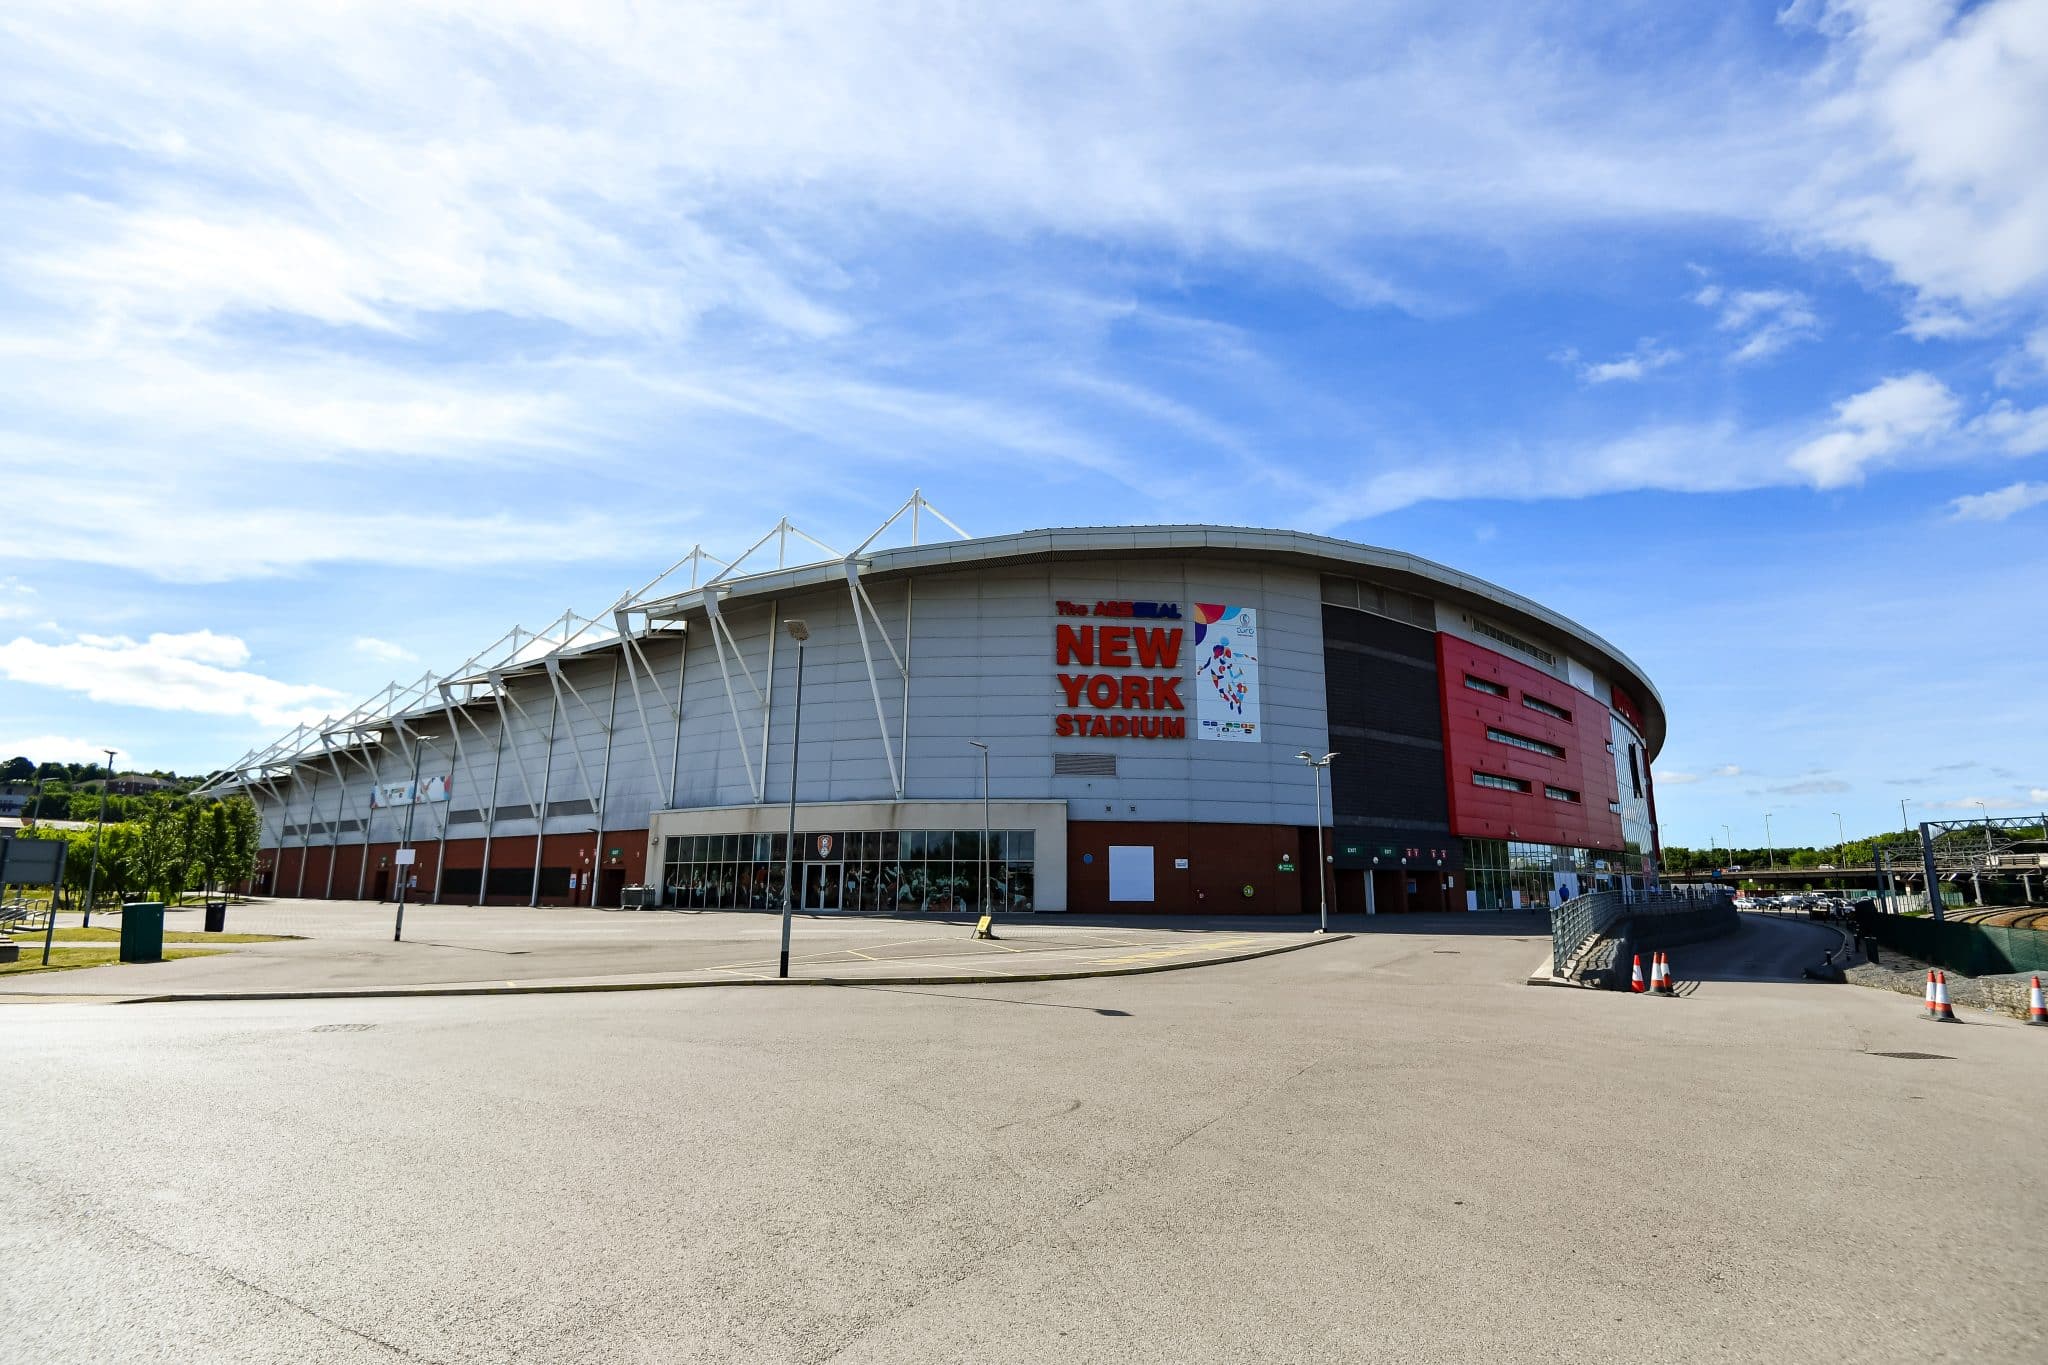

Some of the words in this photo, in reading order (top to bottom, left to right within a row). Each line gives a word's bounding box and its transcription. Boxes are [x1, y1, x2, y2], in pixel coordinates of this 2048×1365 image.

[1056, 624, 1183, 669] NEW
[1056, 673, 1185, 710] YORK
[1055, 713, 1185, 739] STADIUM
